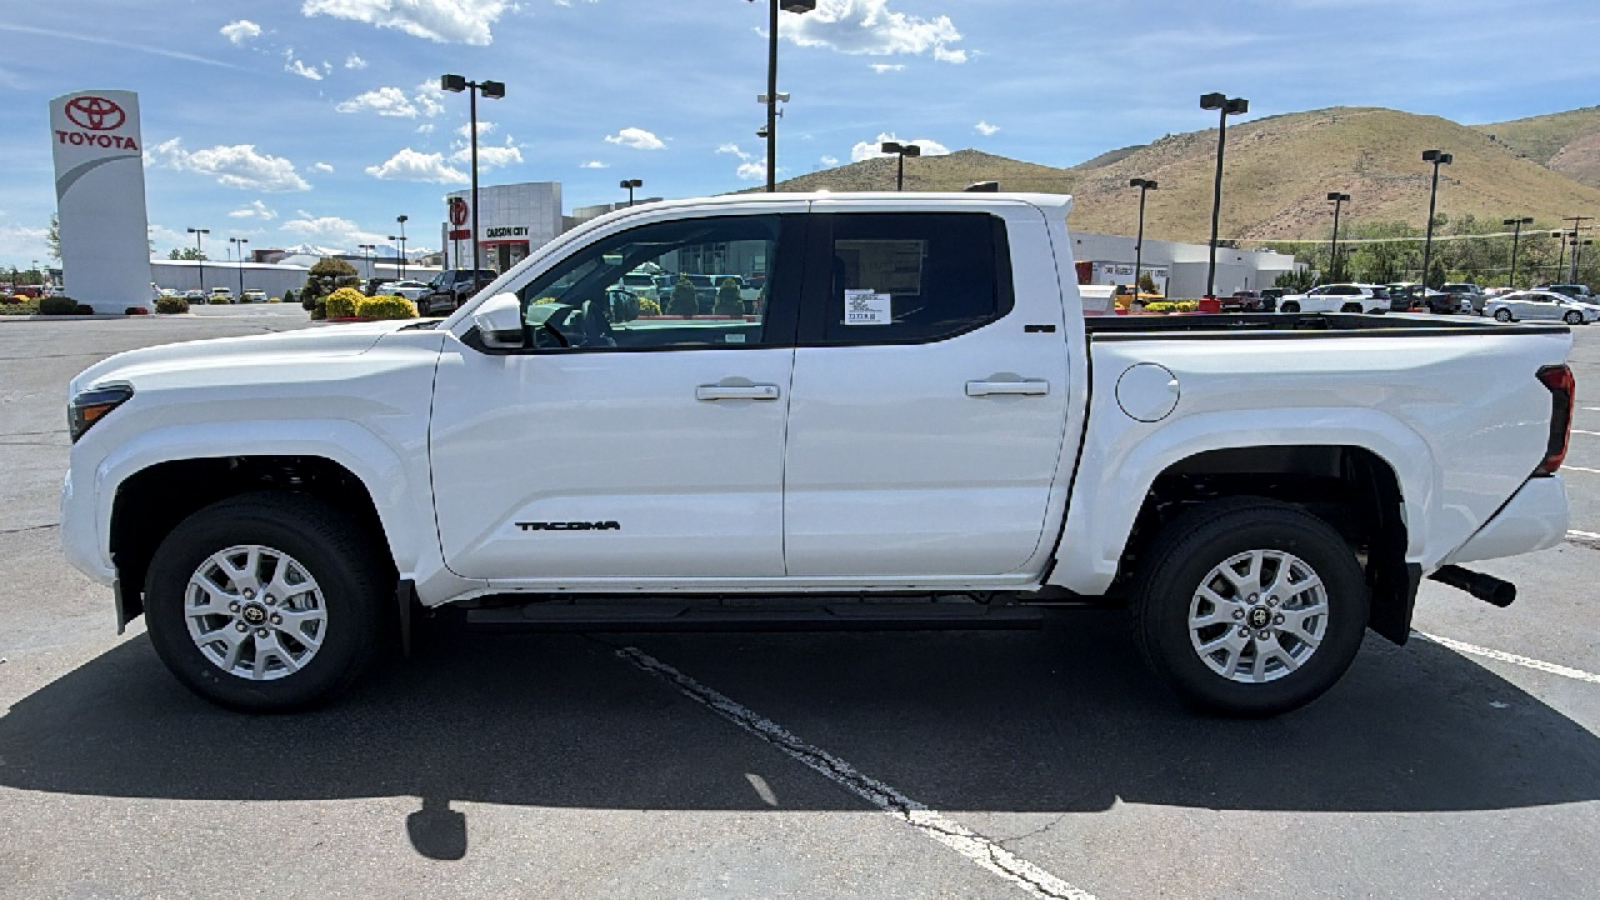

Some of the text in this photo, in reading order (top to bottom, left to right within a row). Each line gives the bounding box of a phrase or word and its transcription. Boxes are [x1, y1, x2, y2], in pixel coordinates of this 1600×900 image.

[55, 130, 138, 150] TOYOTA
[486, 226, 530, 238] CARSON CITY
[514, 520, 620, 531] TACOMA
